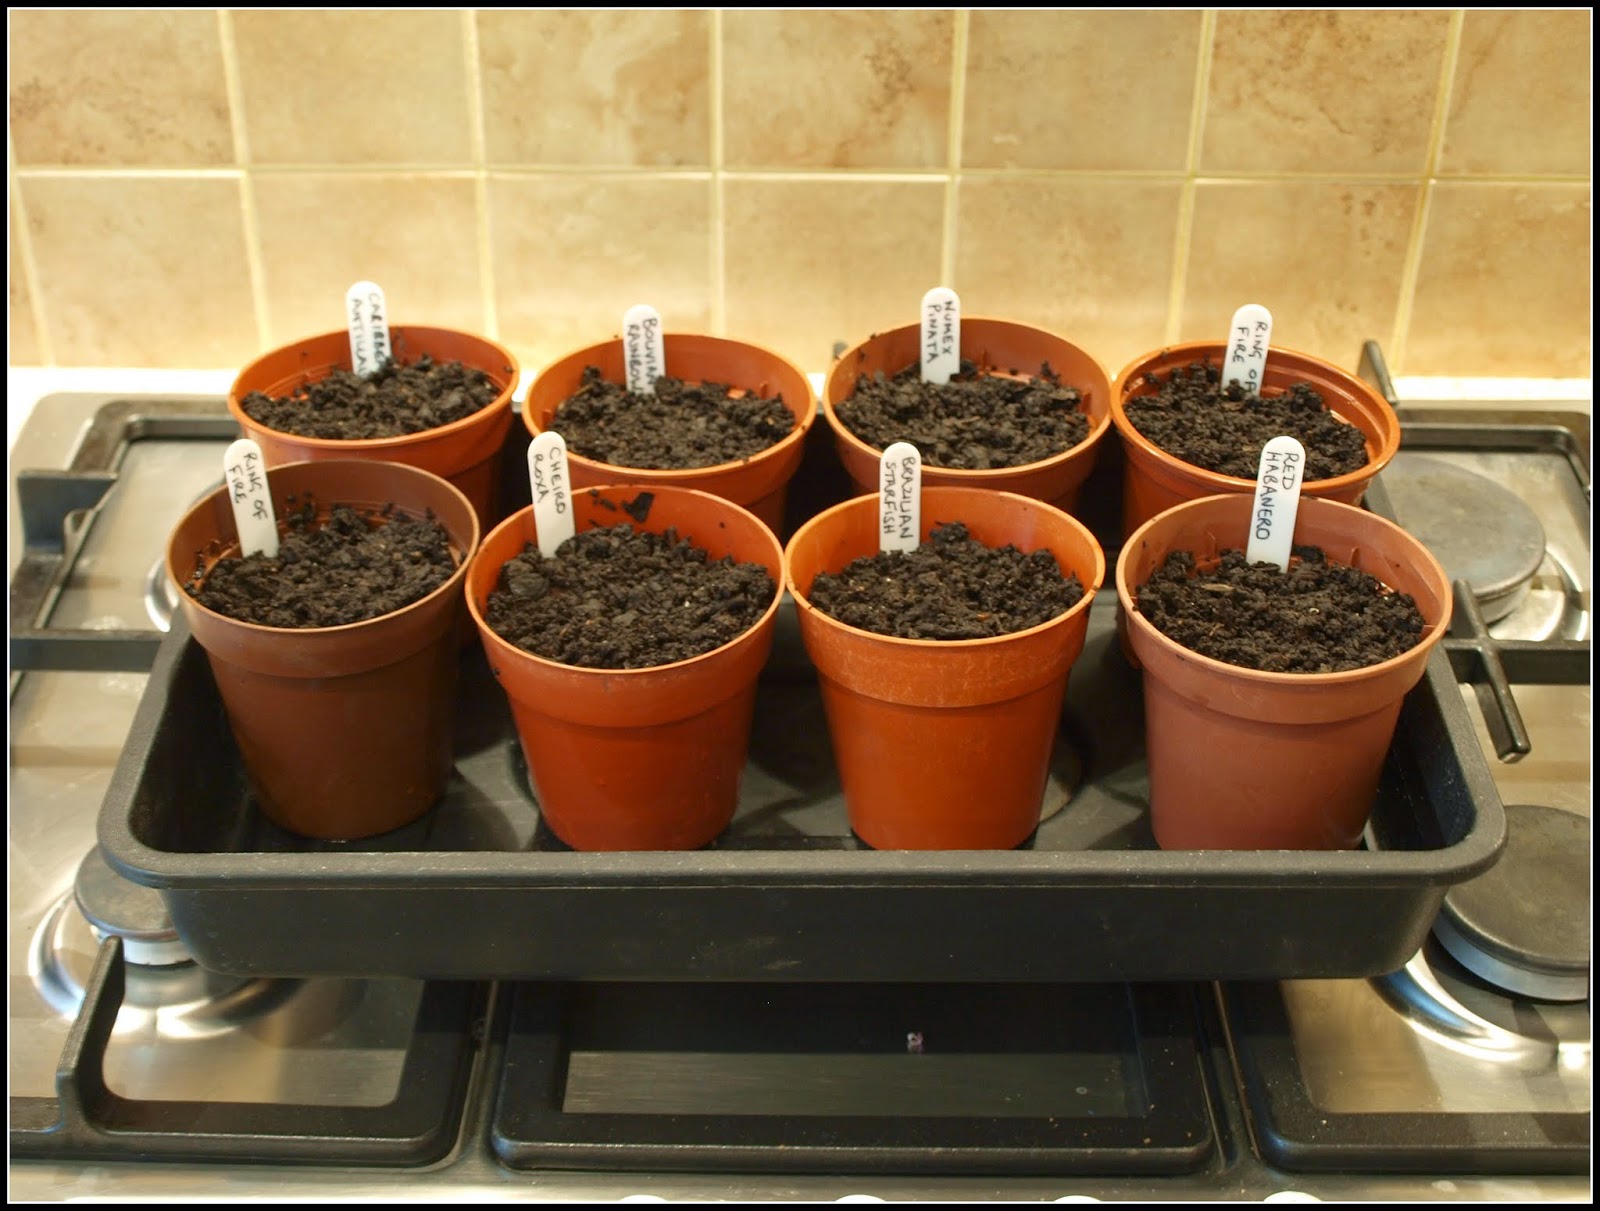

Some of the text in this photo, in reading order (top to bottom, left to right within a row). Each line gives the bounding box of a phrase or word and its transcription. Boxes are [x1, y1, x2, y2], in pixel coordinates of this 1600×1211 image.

[926, 304, 942, 364] PINATA
[942, 300, 955, 355] NUMEX
[1232, 326, 1250, 363] FIRE
[1244, 321, 1268, 391] RING OF
[228, 464, 247, 504] FIRE
[243, 452, 269, 520] RING OF
[534, 453, 550, 503] ROXA
[549, 446, 566, 514] CHEIRO
[883, 462, 898, 534] STARFISH
[898, 456, 916, 539] BRAZILIAN
[1255, 451, 1282, 541] HABANERO
[1281, 452, 1300, 490] RED
